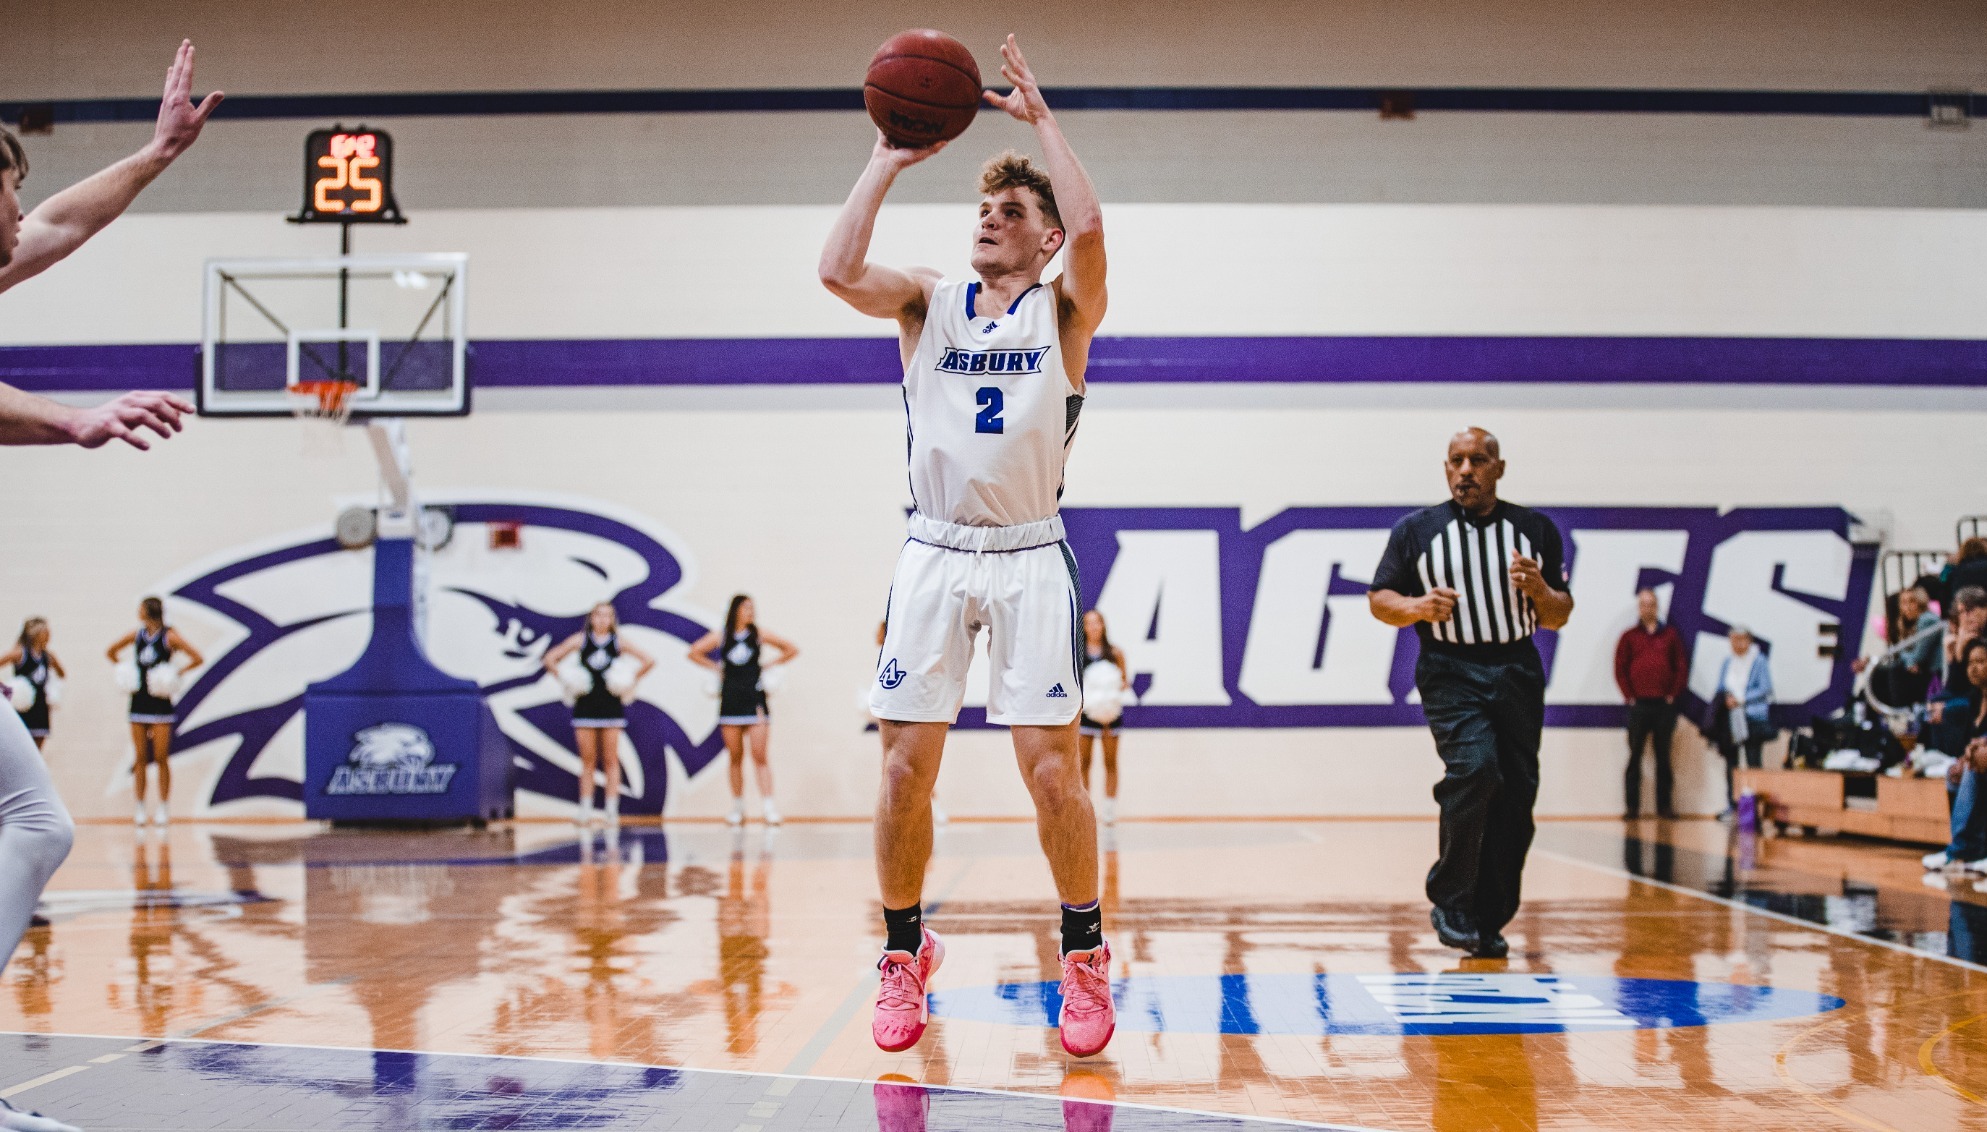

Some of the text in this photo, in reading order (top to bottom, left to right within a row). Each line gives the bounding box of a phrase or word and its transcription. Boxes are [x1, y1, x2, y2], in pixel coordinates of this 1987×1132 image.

[314, 155, 382, 213] 25
[941, 351, 1042, 372] ASBURY
[975, 387, 1004, 434] 2
[950, 528, 1854, 706] AGES
